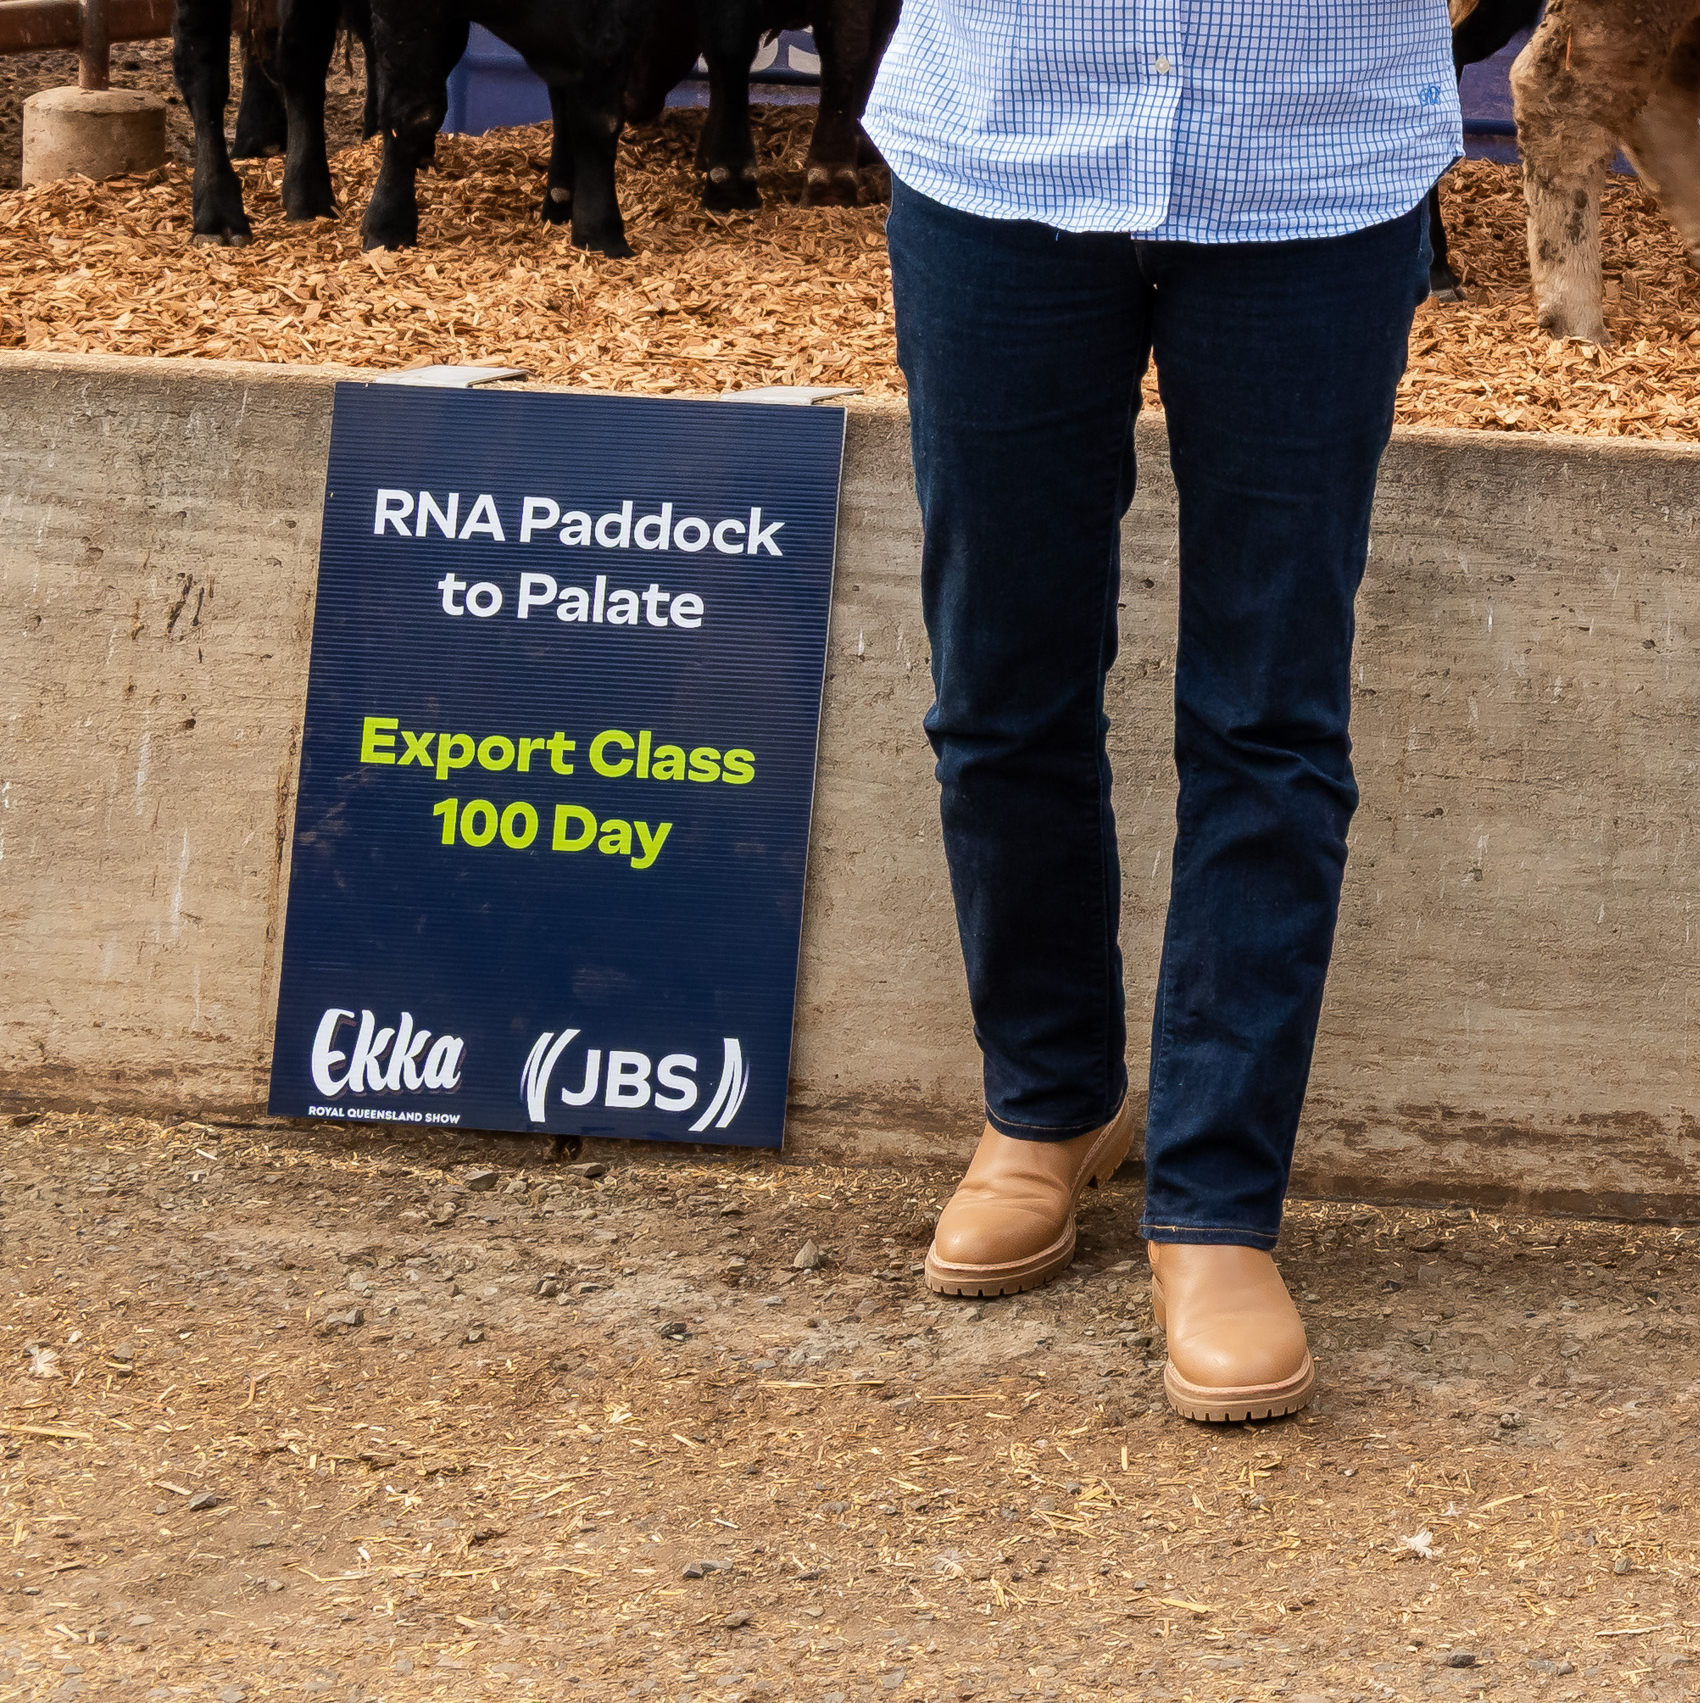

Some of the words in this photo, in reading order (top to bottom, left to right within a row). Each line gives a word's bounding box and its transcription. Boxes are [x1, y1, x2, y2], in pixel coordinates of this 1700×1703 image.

[373, 488, 506, 542] RNA
[519, 496, 786, 557] Paddock
[437, 572, 503, 618] to
[516, 571, 705, 629] Palate
[360, 716, 576, 781] Export
[588, 729, 757, 785] Class
[432, 797, 539, 850] 100
[551, 804, 673, 870] Day
[311, 1008, 465, 1097] Ekka
[561, 1049, 699, 1112] JBS
[308, 1105, 345, 1118] ROYAL
[347, 1107, 423, 1123] QUEENSLAND
[424, 1112, 461, 1125] SHOW
